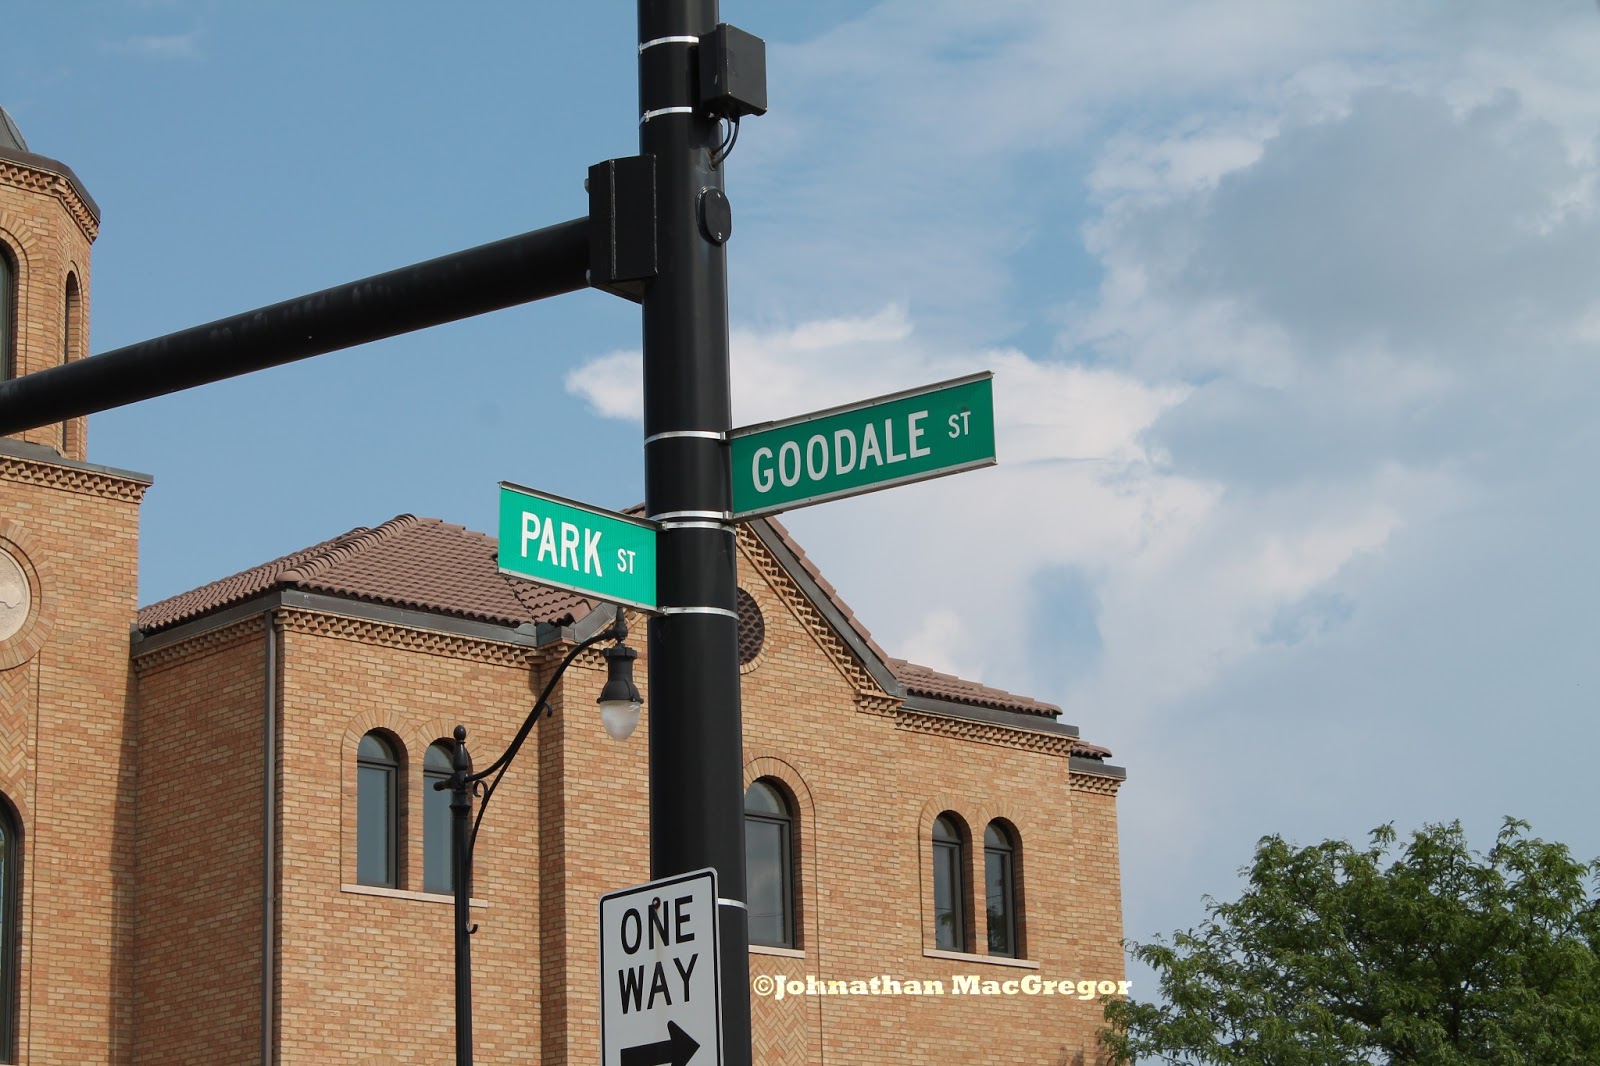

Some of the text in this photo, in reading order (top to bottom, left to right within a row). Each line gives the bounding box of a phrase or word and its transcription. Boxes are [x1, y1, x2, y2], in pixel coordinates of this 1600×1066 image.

[751, 410, 972, 493] GOODALE ST
[520, 510, 636, 577] PARK ST
[620, 895, 695, 955] ONE
[618, 953, 699, 1014] WAY
